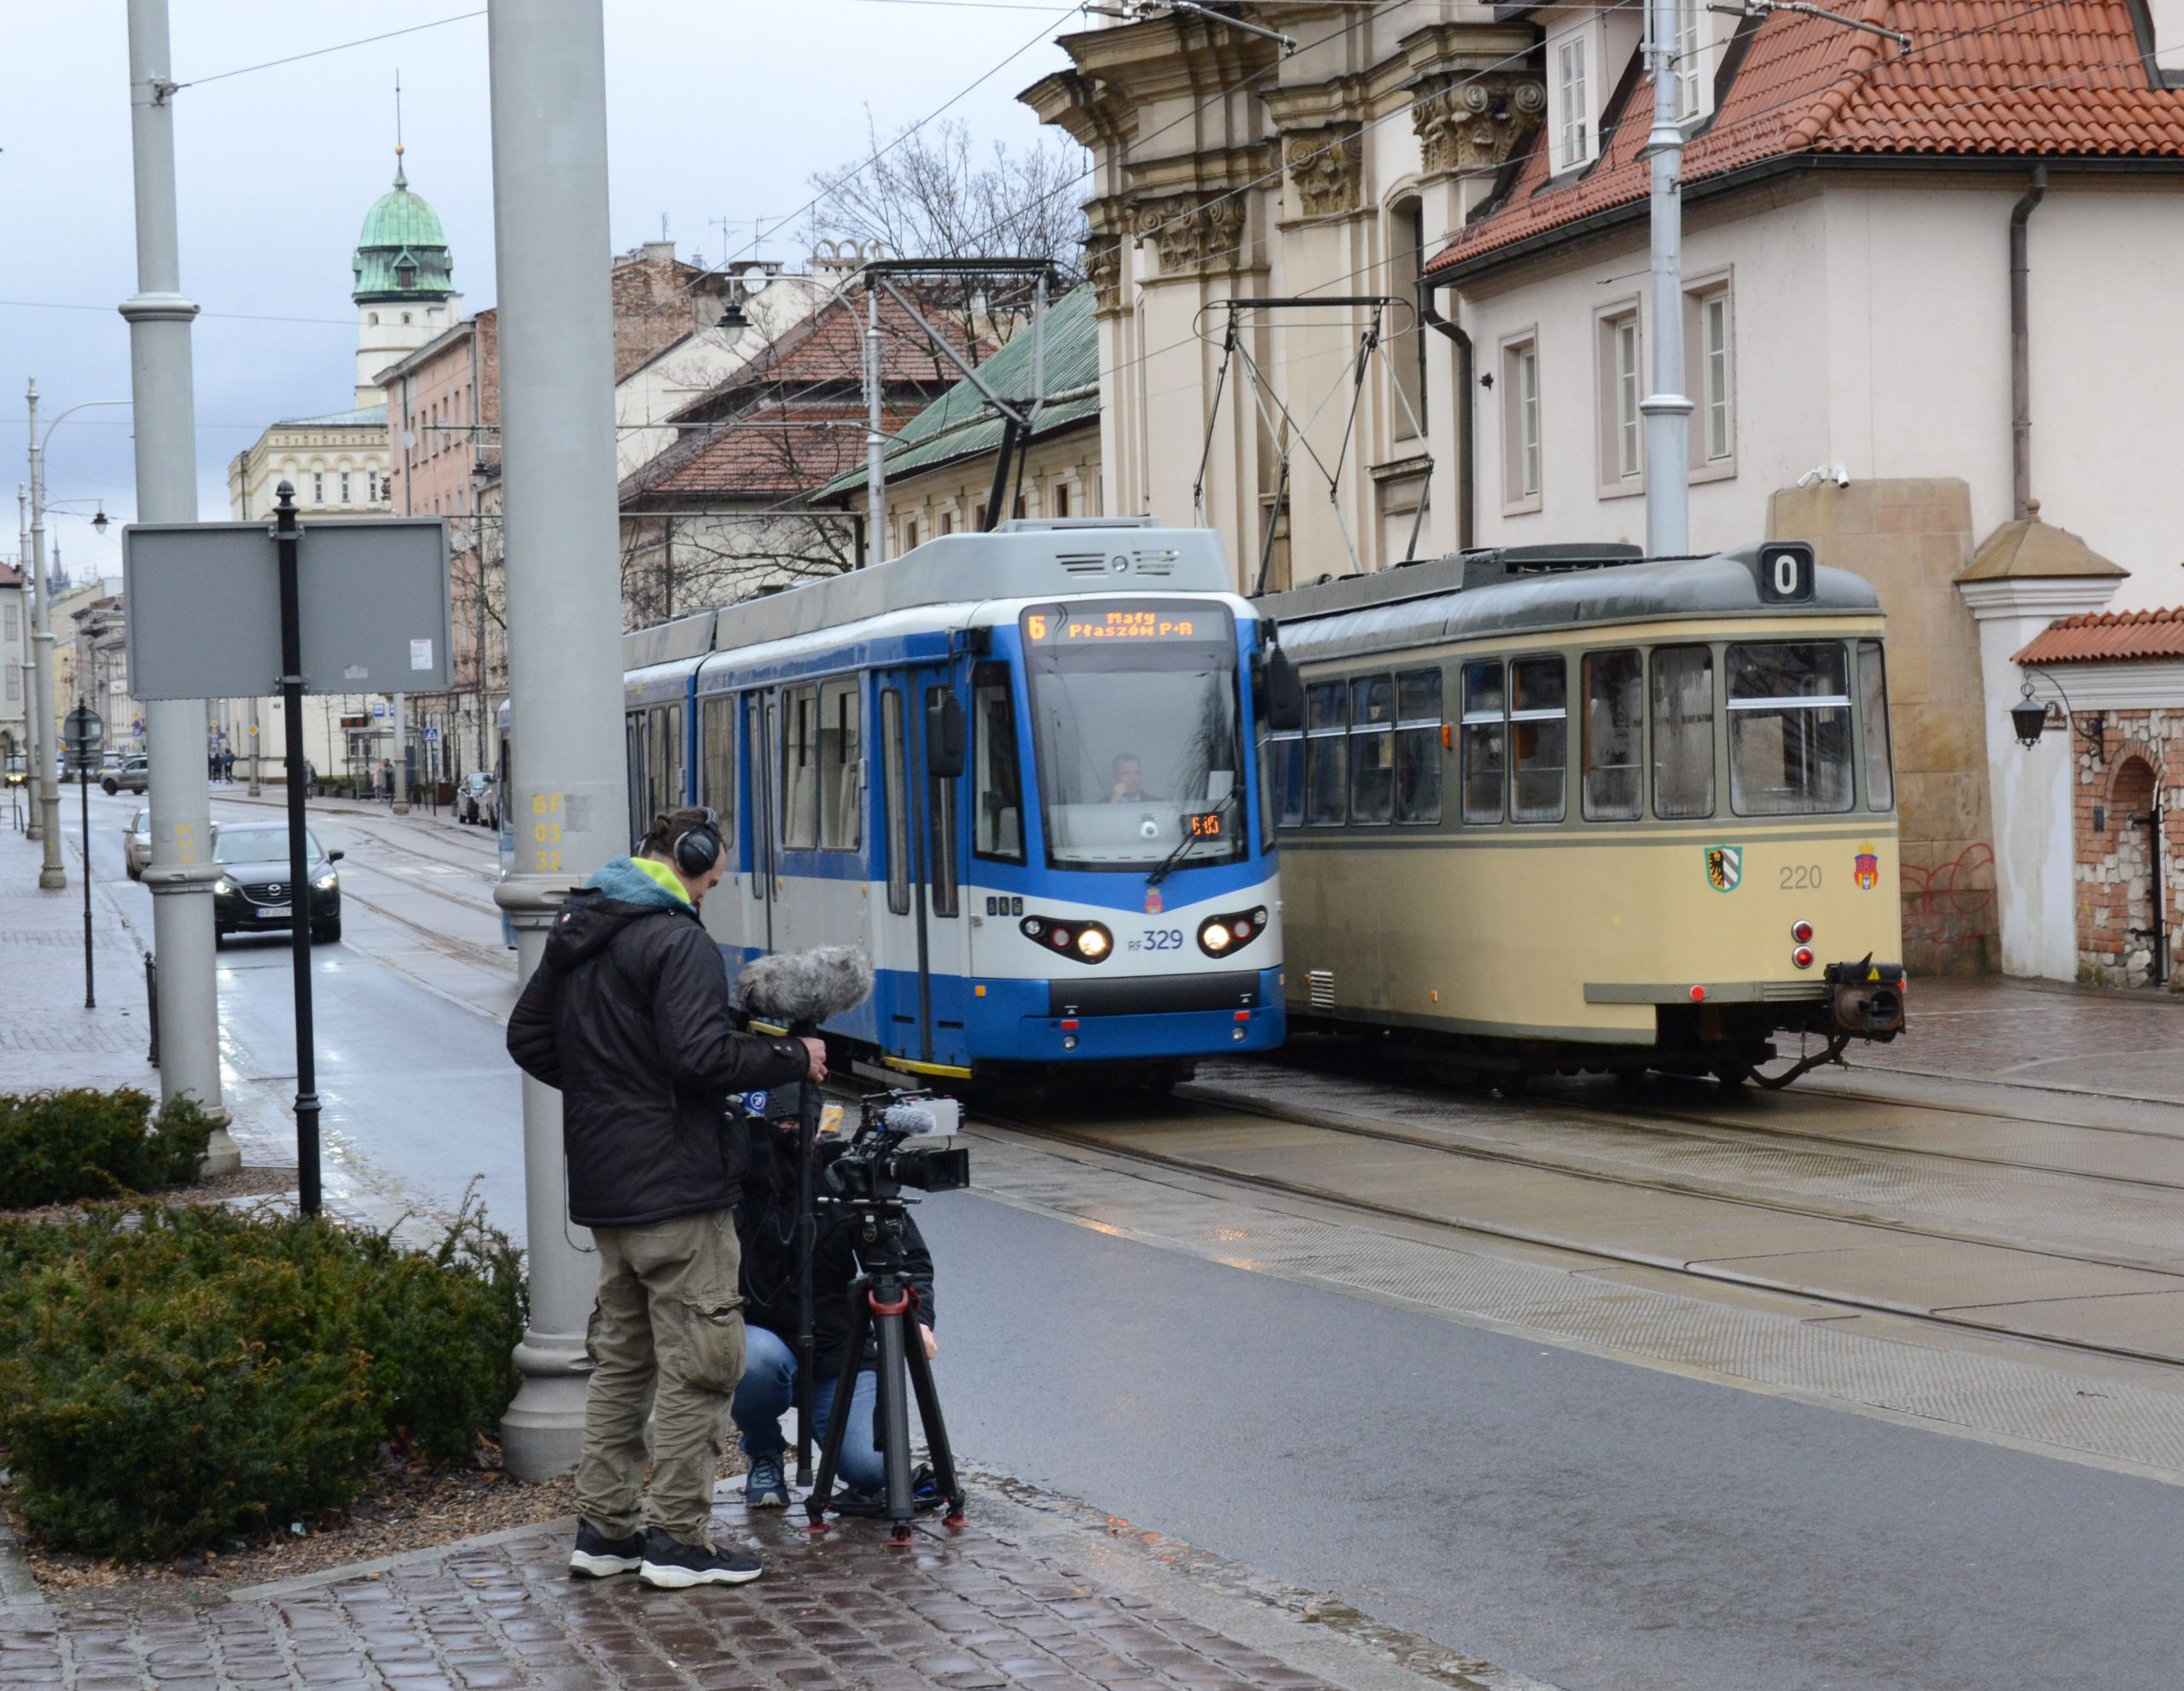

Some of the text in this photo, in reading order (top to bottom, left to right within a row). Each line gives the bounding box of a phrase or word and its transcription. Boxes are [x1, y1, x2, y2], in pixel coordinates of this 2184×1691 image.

[1775, 555, 1798, 595] 0
[1029, 616, 1046, 640] 6
[532, 793, 562, 815] BF
[535, 822, 561, 843] 03
[1780, 864, 1822, 890] 220
[1143, 929, 1182, 950] 329
